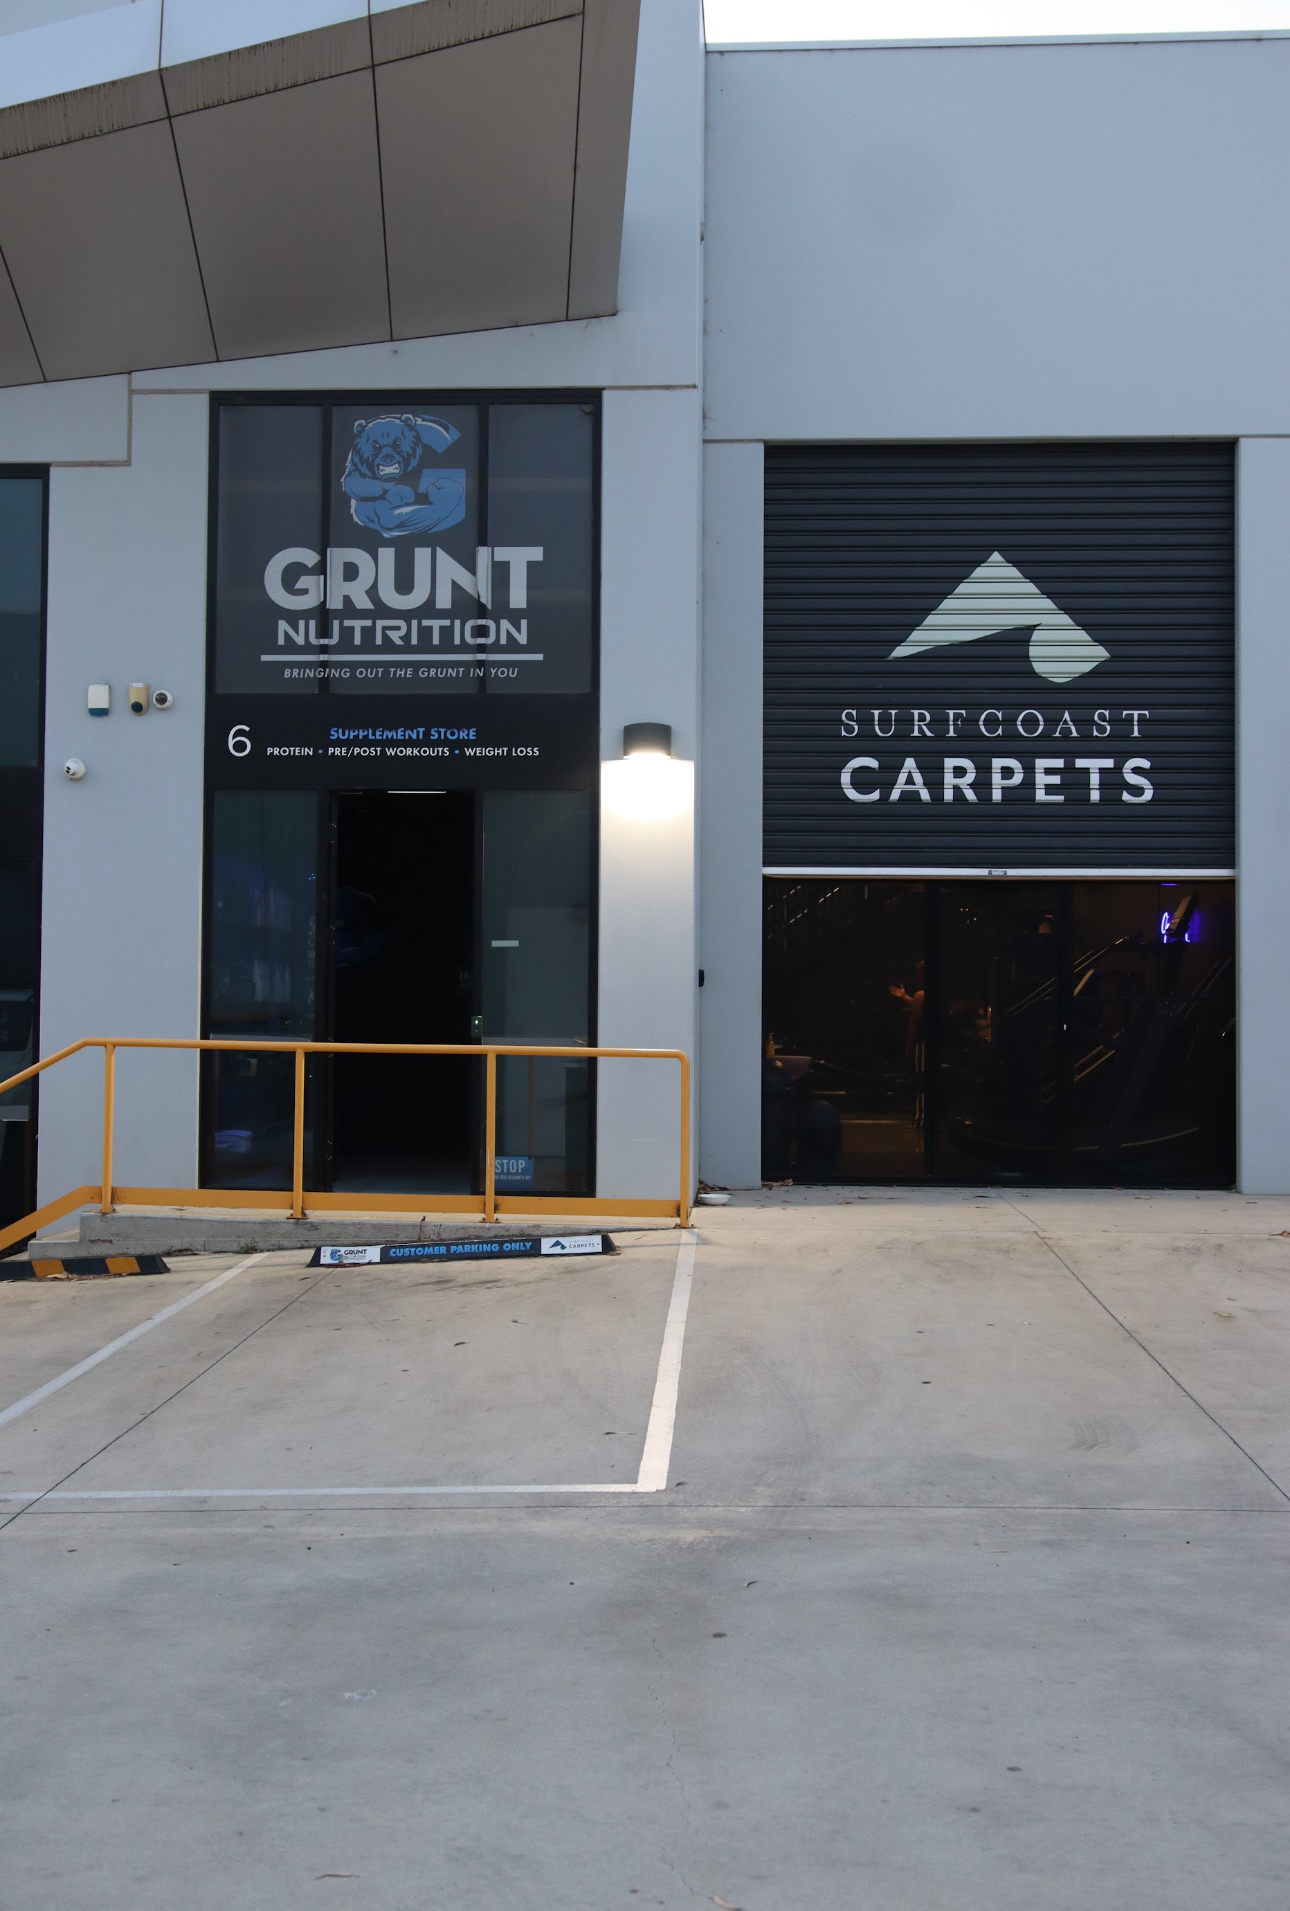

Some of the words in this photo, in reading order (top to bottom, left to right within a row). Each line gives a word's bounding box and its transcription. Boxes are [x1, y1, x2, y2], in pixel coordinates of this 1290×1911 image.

[263, 546, 544, 610] GRUNT
[277, 618, 528, 646] NUTRITION
[283, 667, 351, 679] BRINGING
[356, 667, 385, 679] OUT
[389, 667, 413, 678] THE
[418, 667, 465, 678] GRUNT
[469, 667, 485, 678] IN
[490, 667, 518, 678] YOU
[329, 727, 425, 740] SUPPLEMENT
[430, 727, 477, 740] STORE
[841, 709, 1150, 738] SURFCOAST
[227, 724, 252, 757] 6
[266, 746, 314, 756] PROTEIN
[328, 746, 382, 758] PRE/POST
[385, 746, 450, 757] WORKOUTS
[464, 746, 509, 757] WEIGHT
[512, 746, 540, 757] LOSS
[841, 756, 1154, 803] CARPETS
[495, 1160, 526, 1173] STOP
[389, 1246, 447, 1257] CUSTOMER
[450, 1243, 499, 1254] PARKING
[503, 1241, 532, 1251] ONLY
